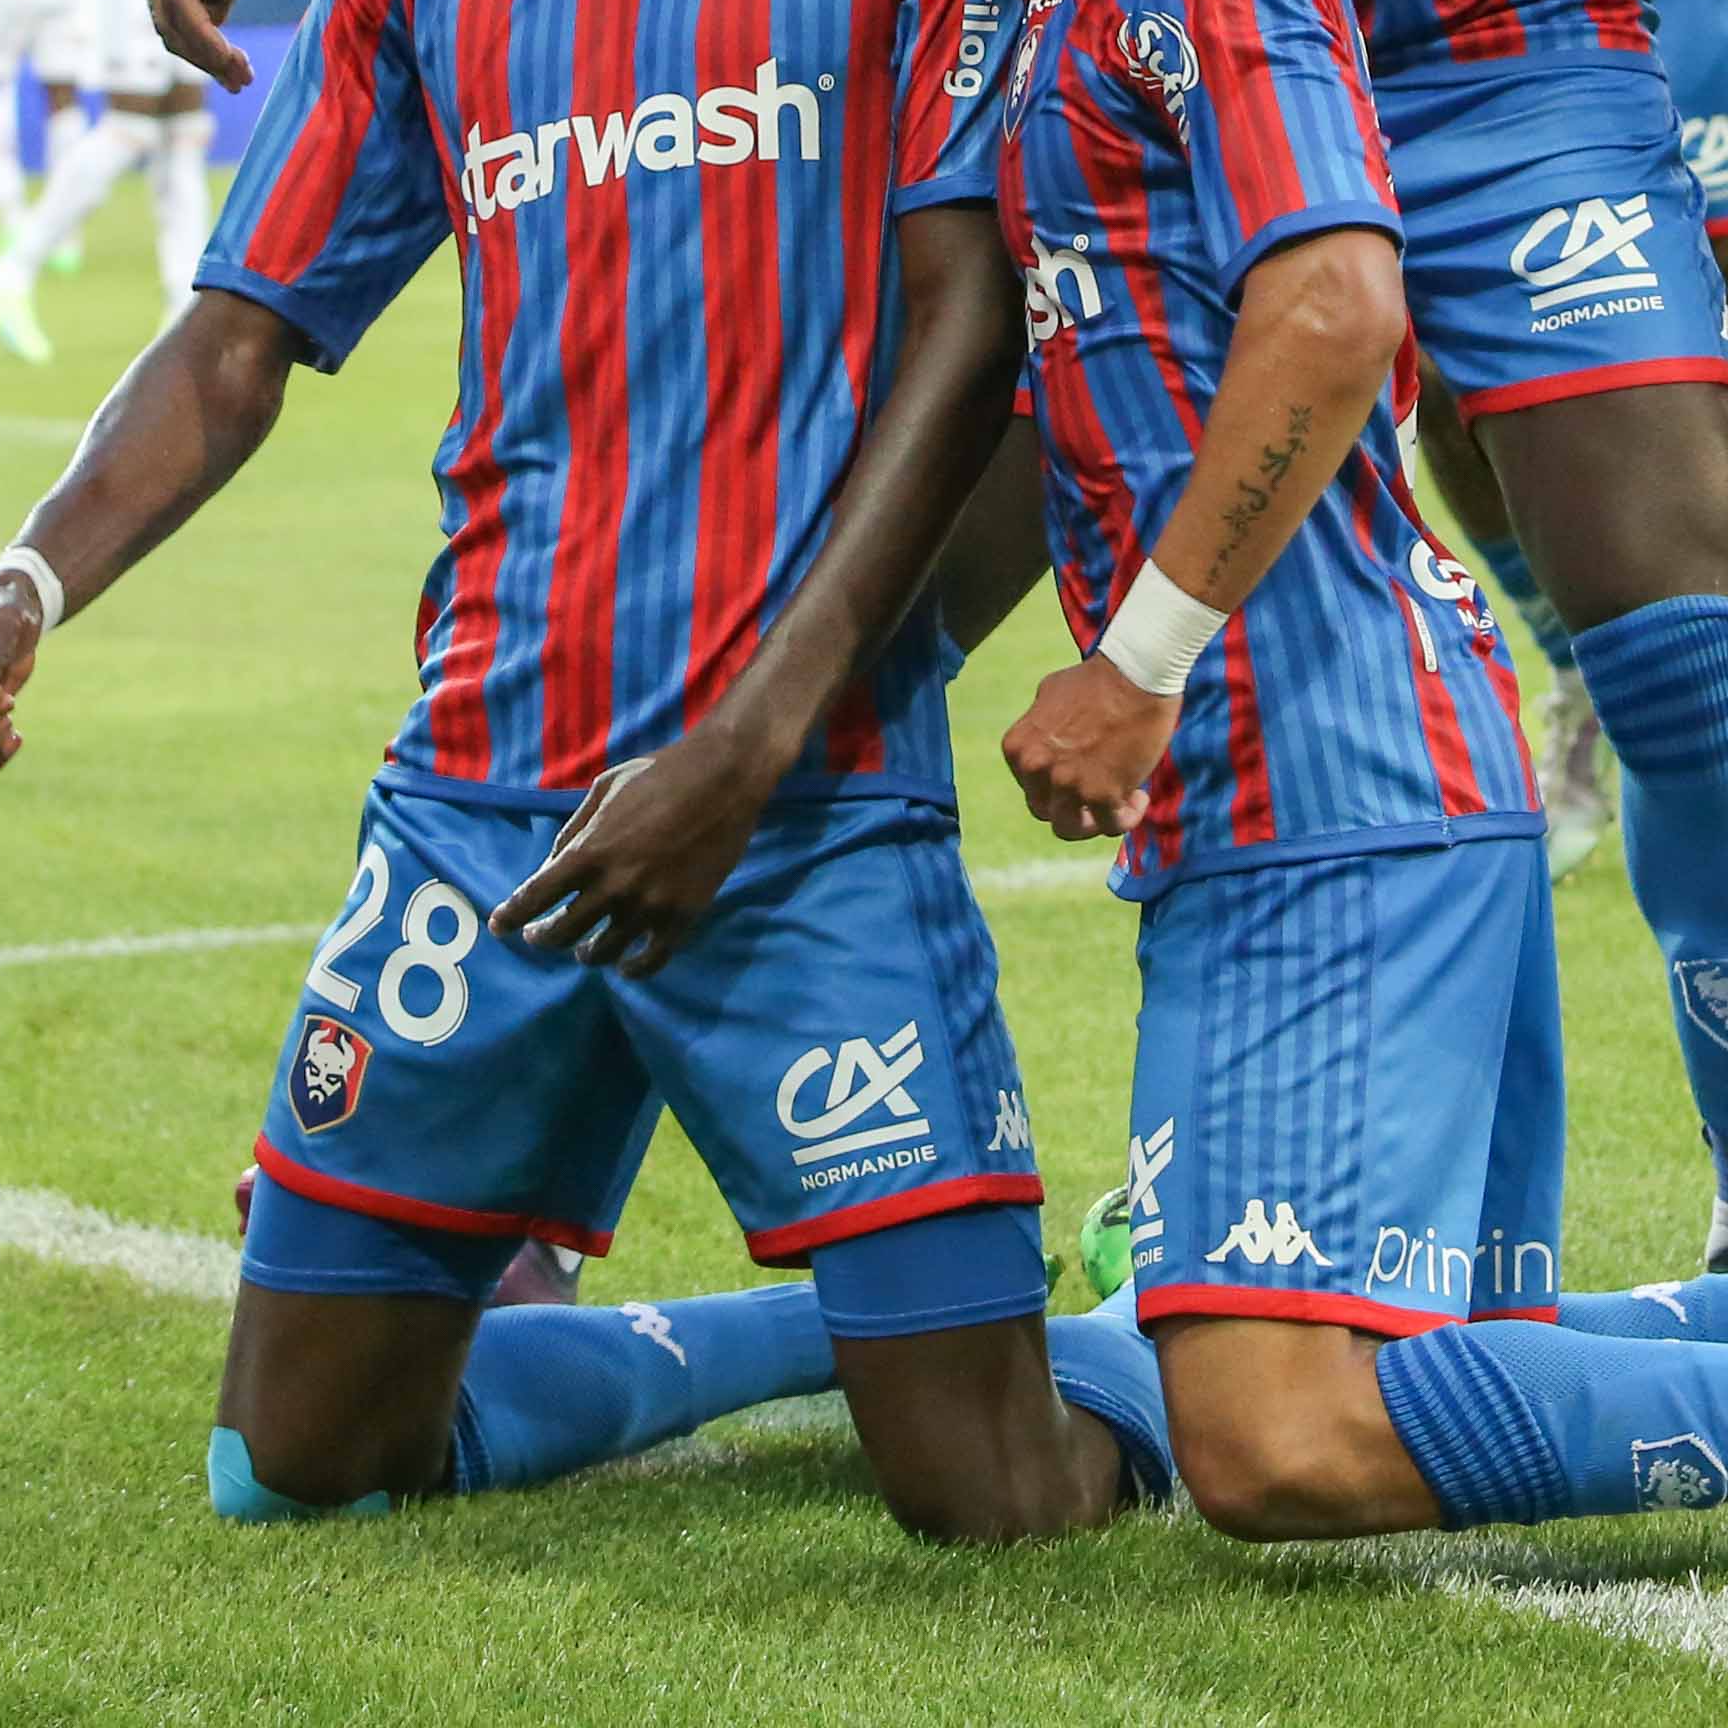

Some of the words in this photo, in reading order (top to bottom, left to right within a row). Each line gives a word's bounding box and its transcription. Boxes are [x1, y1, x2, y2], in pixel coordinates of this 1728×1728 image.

[1531, 294, 1665, 334] NORMANDIE
[305, 843, 478, 1047] 28
[801, 1142, 937, 1191] NORMANDIE
